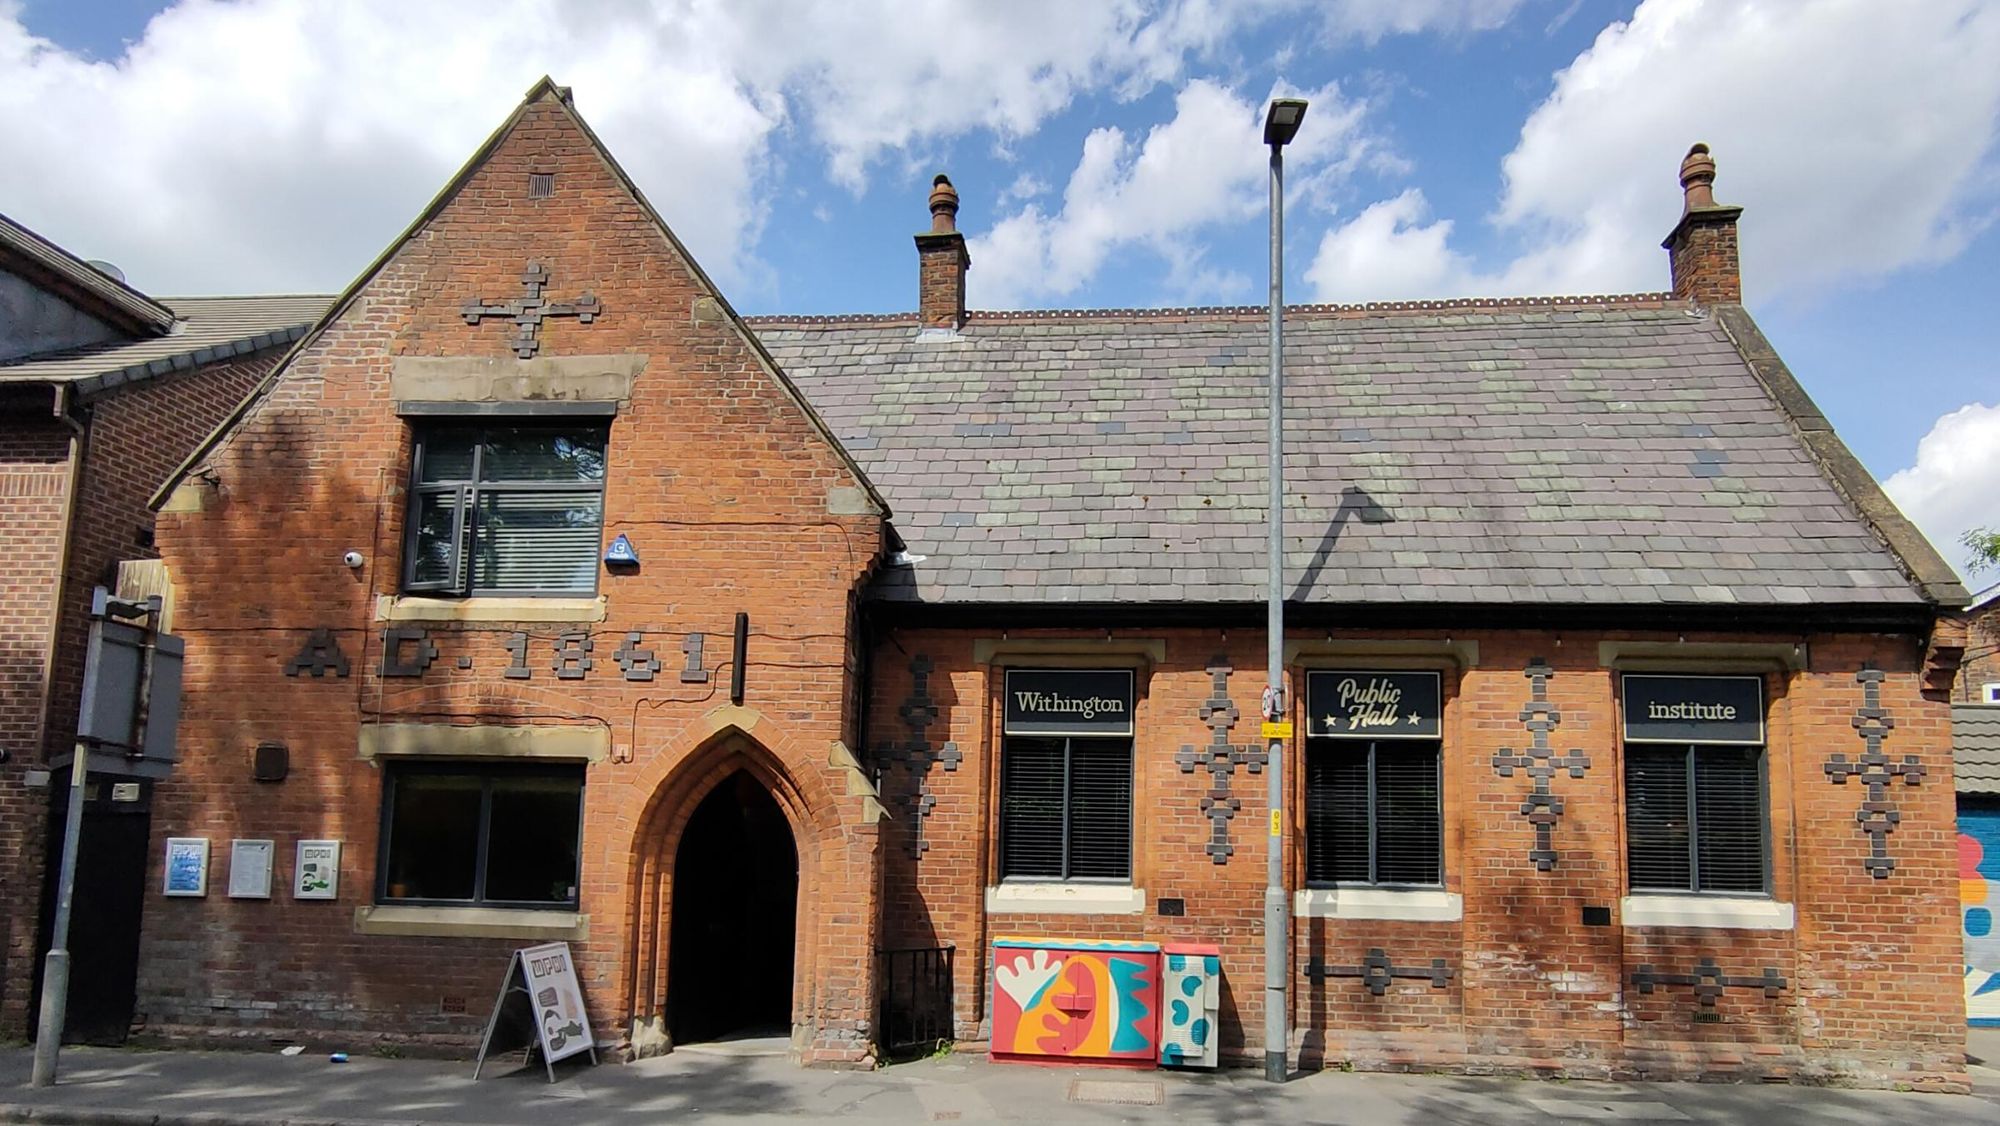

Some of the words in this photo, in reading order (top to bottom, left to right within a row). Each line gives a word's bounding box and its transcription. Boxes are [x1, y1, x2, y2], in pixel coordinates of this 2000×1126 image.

[504, 631, 708, 681] 1861
[1014, 691, 1125, 719] Withington
[1336, 678, 1402, 708] Public
[1347, 703, 1399, 730] Hall
[1648, 701, 1737, 720] institute
